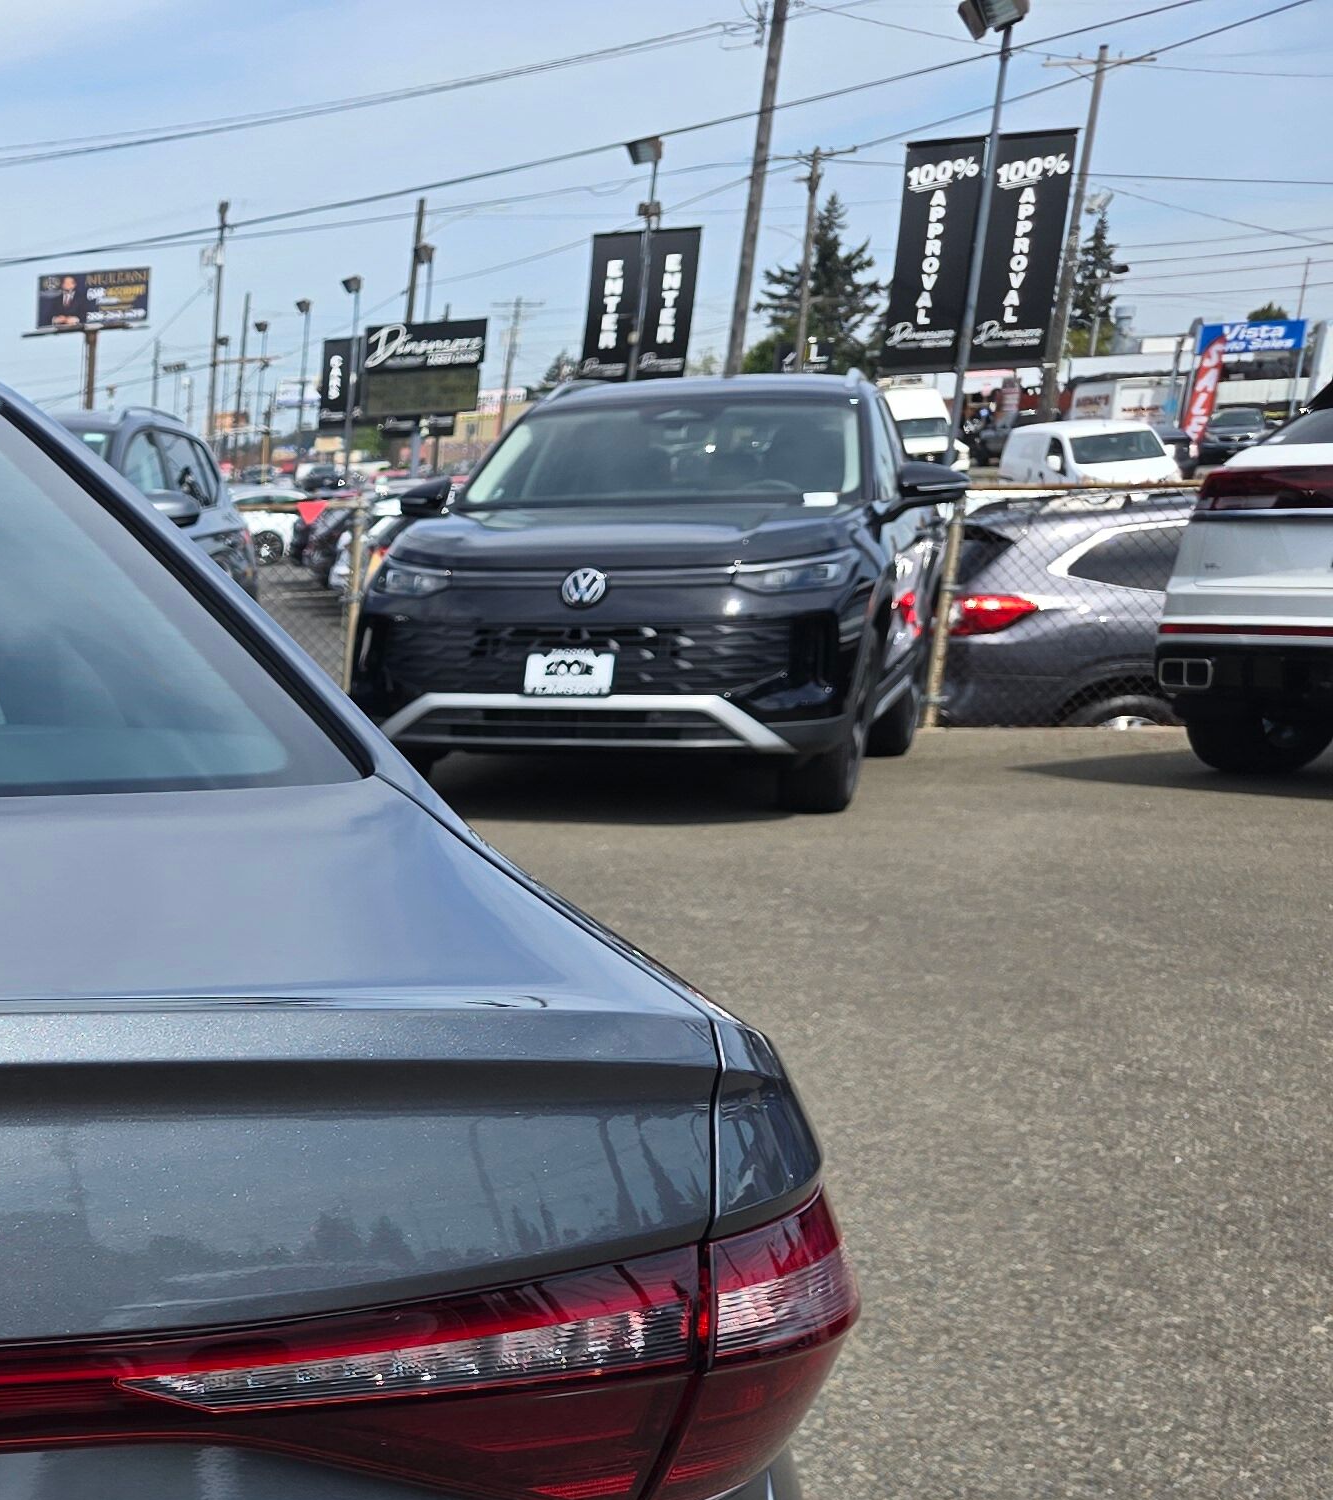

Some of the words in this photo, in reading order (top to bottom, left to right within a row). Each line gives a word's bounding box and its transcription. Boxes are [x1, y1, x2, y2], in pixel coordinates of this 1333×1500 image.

[907, 156, 980, 187] 100%
[997, 153, 1071, 184] 100%
[656, 253, 683, 344] ENTER
[915, 189, 947, 326] APPROVAL
[1002, 186, 1036, 324] APPROVAL
[597, 259, 624, 350] ENTER
[1222, 324, 1286, 341] Vista
[1185, 342, 1224, 442] SALE
